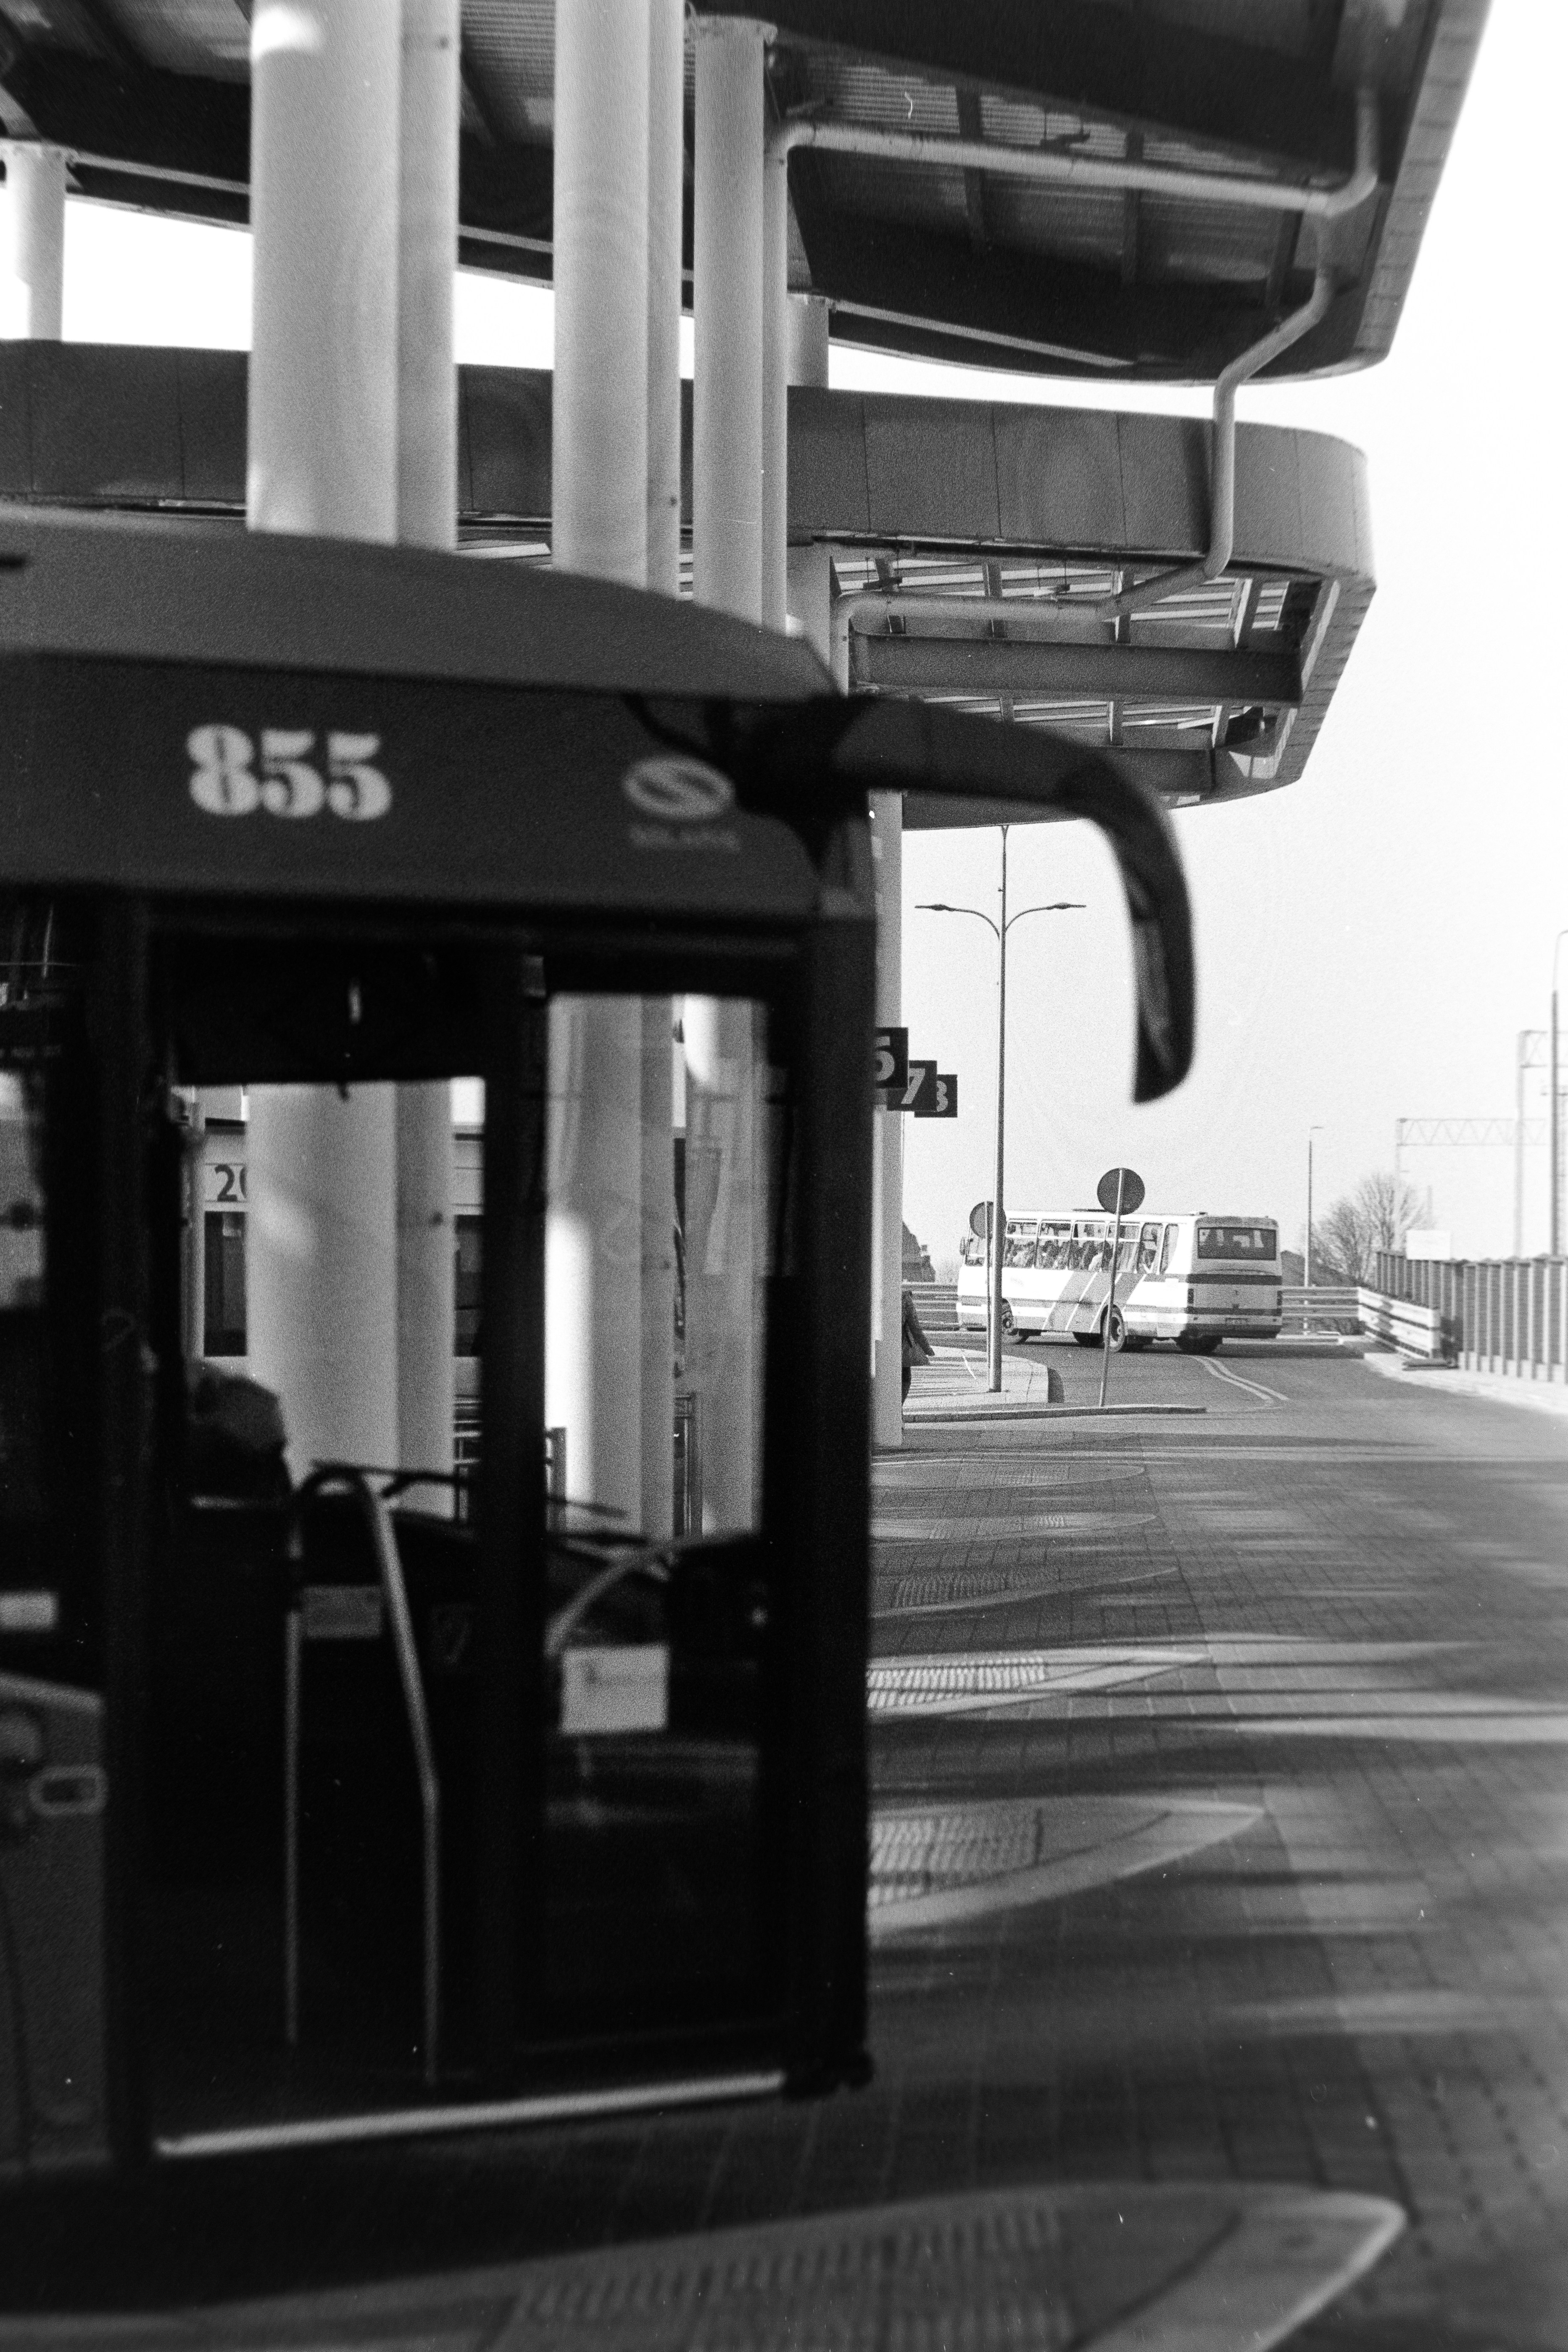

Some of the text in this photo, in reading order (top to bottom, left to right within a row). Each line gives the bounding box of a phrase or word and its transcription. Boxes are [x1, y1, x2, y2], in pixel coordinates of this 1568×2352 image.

[186, 724, 393, 822] 855
[901, 1068, 925, 1104] 7
[214, 1164, 247, 1202] 2
